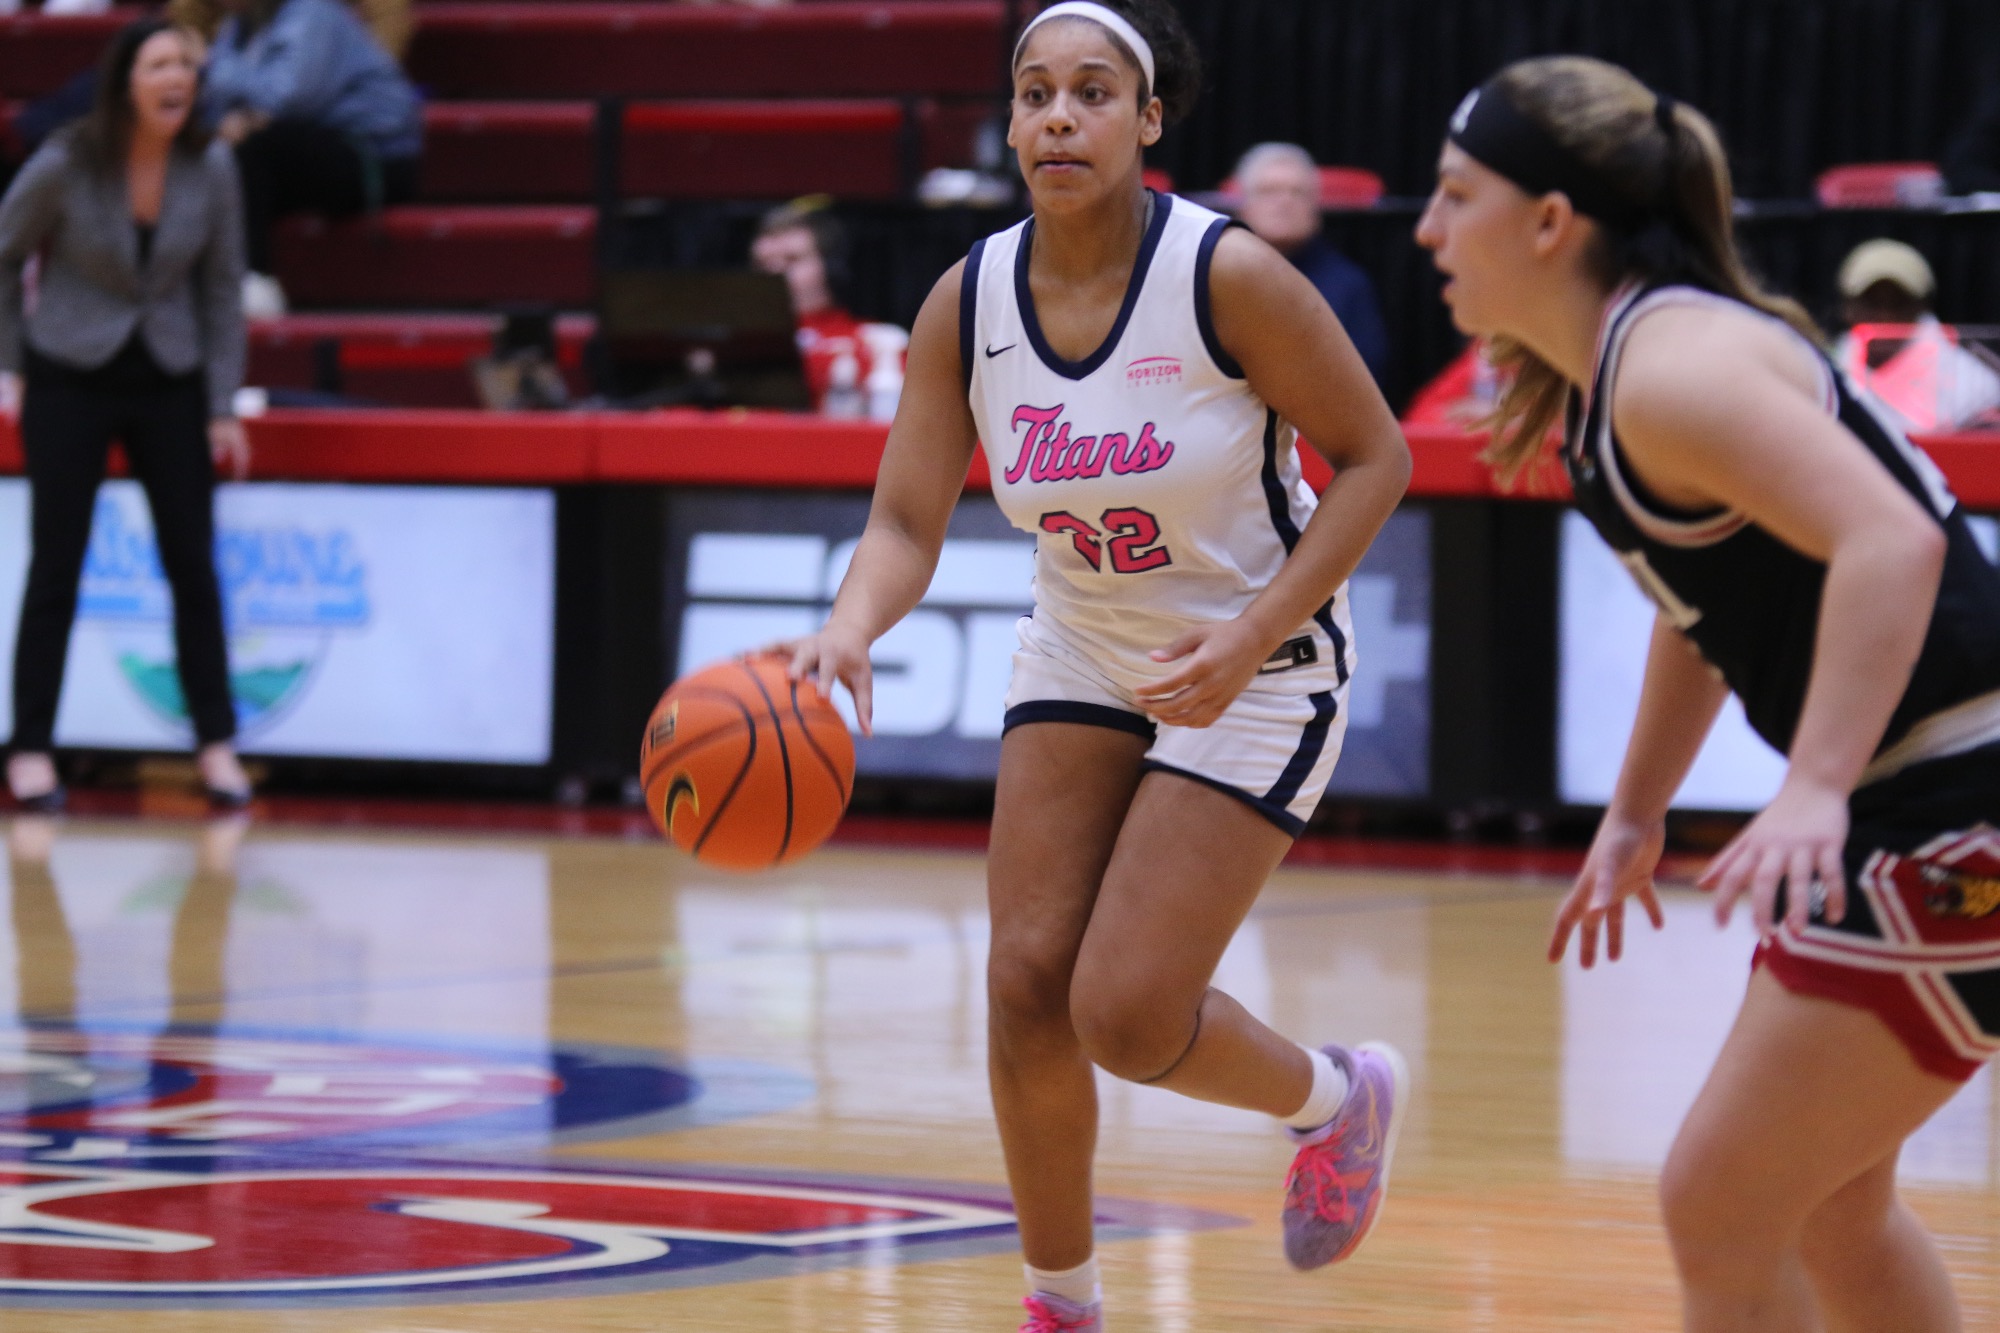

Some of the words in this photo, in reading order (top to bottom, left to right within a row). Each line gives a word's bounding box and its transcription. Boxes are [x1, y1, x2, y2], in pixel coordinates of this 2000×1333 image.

[1126, 364, 1182, 380] HORIZON
[1004, 403, 1175, 485] Titans
[1039, 506, 1172, 574] 22
[1299, 647, 1309, 659] L
